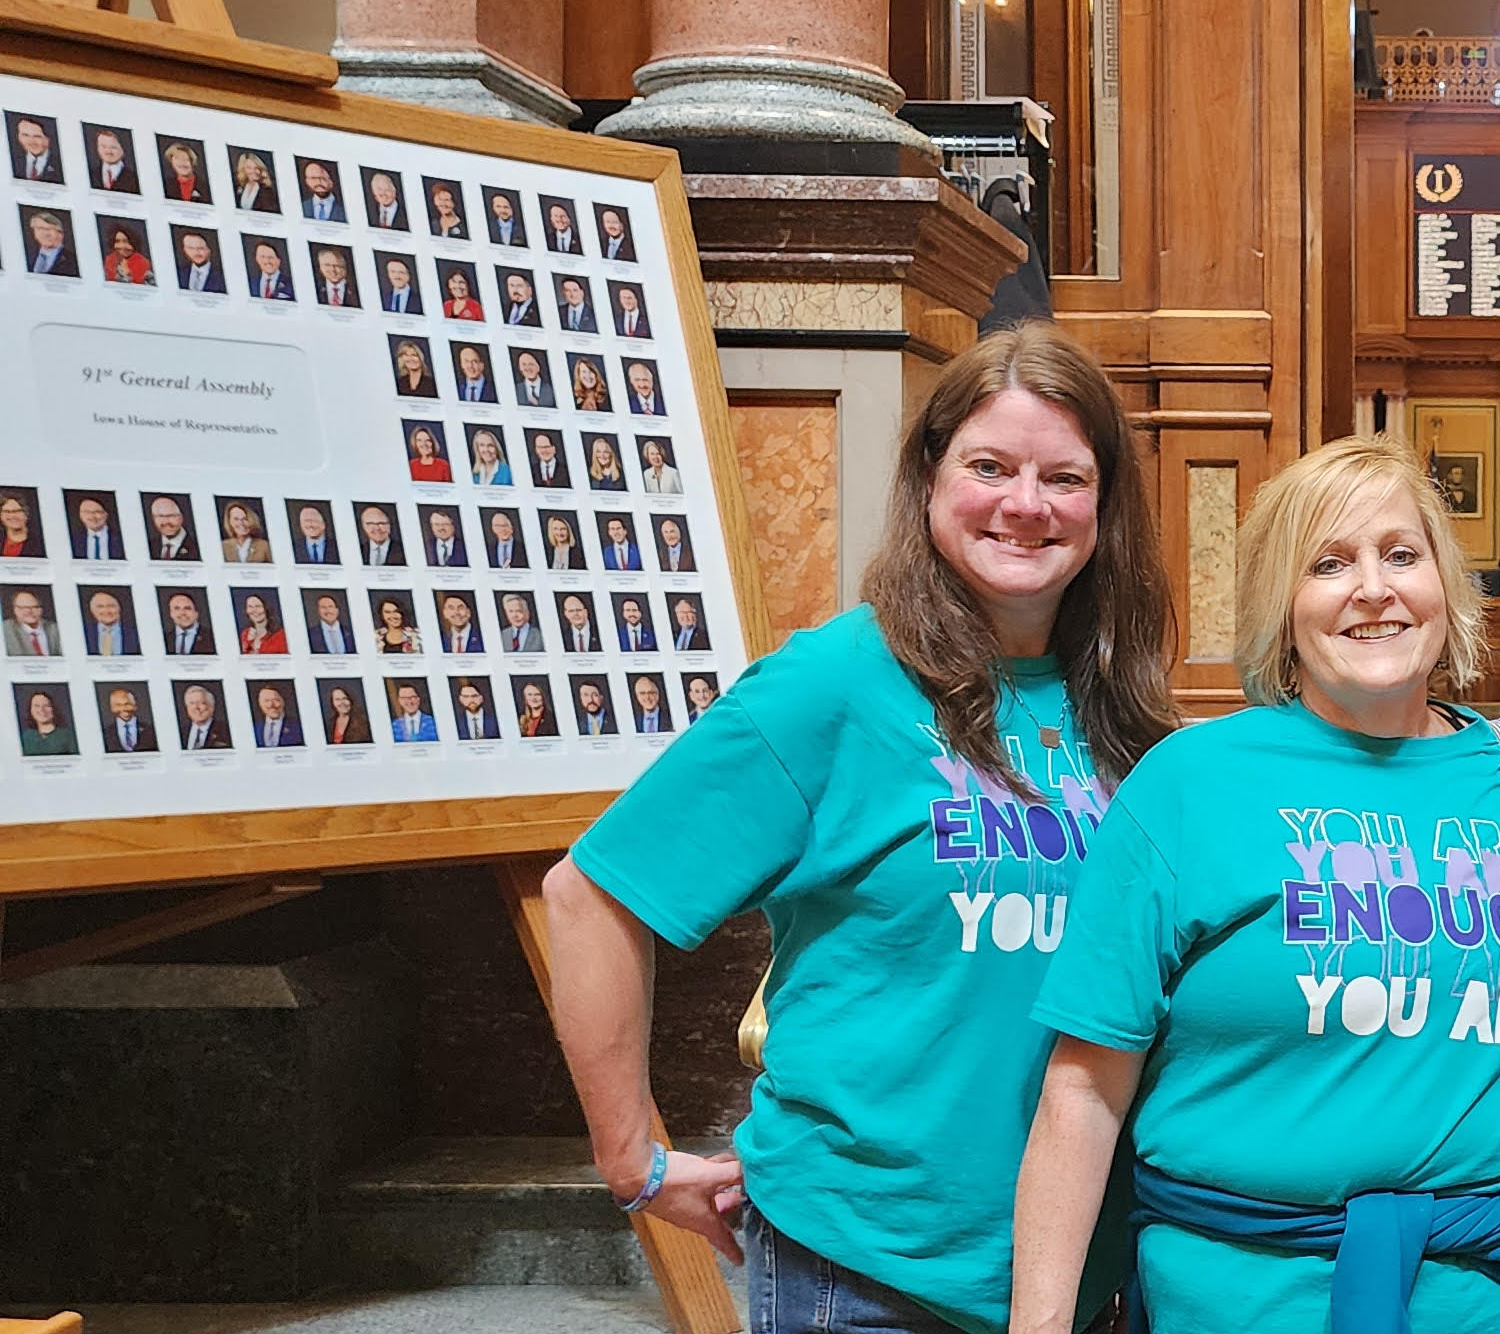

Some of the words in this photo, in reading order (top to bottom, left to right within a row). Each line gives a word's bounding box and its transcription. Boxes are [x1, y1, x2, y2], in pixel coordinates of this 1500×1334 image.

[81, 366, 113, 384] 91st
[119, 370, 190, 391] General
[195, 378, 275, 400] Assembly
[92, 413, 125, 425] Iowa
[127, 415, 166, 429] House
[169, 419, 182, 428] of
[184, 419, 279, 435] Representatives
[1278, 807, 1410, 859] YOU
[1285, 840, 1420, 891] YOU
[949, 891, 1068, 953] YOU
[1296, 974, 1432, 1037] YOU
